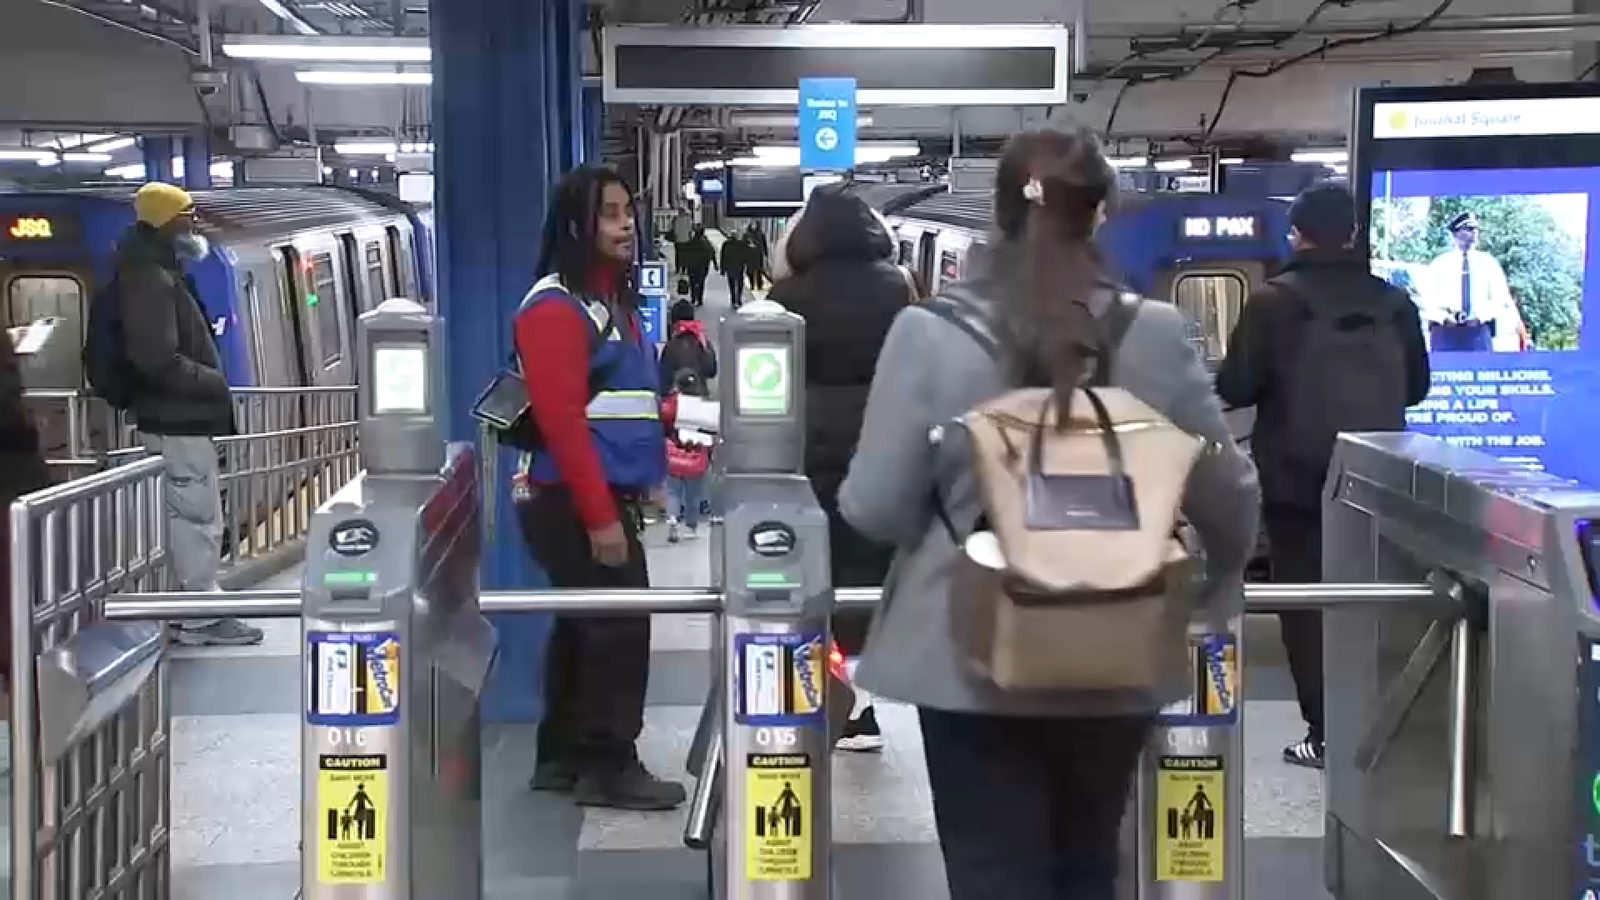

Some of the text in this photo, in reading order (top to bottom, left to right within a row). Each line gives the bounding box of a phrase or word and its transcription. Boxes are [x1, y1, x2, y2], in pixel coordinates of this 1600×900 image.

[1470, 110, 1522, 127] Square
[1216, 216, 1254, 236] PAX
[1455, 385, 1497, 397] YOUR
[1467, 399, 1499, 411] LIFE
[1436, 411, 1489, 423] PROUD
[1486, 435, 1513, 447] THE
[756, 727, 797, 746] 015
[325, 757, 381, 768] CAUTION
[752, 756, 806, 766] CAUTION
[1163, 759, 1218, 769] CAUTION
